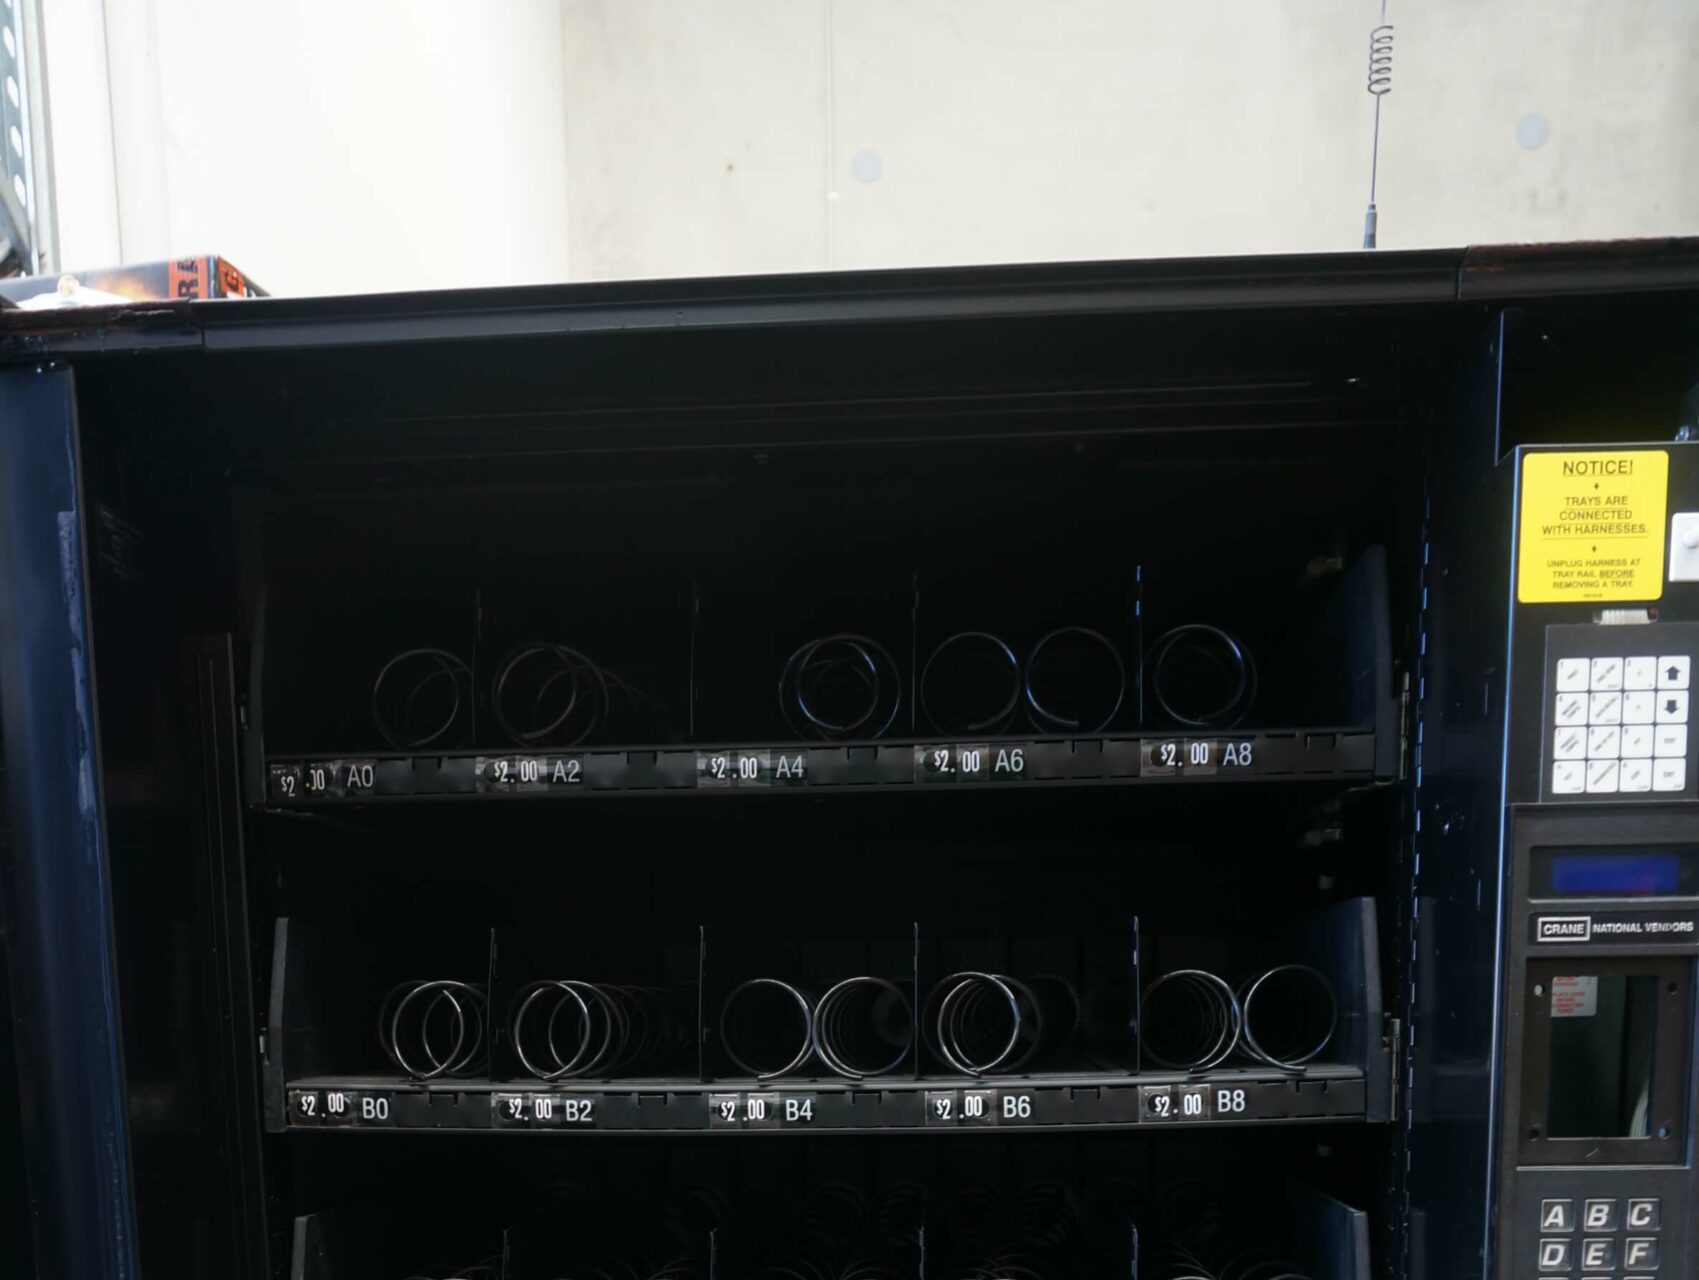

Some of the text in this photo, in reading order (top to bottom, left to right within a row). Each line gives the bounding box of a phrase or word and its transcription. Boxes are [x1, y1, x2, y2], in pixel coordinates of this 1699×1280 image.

[1563, 460, 1633, 475] NOTICE!
[1565, 496, 1629, 506] TRAYS ARE
[1559, 510, 1633, 521] CONNECTED
[1542, 524, 1649, 535] WITH HARNESSES.
[1547, 560, 1583, 568] UNPLUG
[1630, 558, 1640, 566] AT
[1577, 570, 1596, 578] RAIL
[1600, 569, 1634, 577] BEFORE
[1552, 581, 1599, 589] REMOVING
[994, 749, 1024, 772] A6
[1222, 742, 1252, 766] A8
[347, 765, 374, 787] A0
[552, 760, 580, 783] A2
[776, 755, 804, 778] A4
[1543, 921, 1694, 935] CRANE NATIONAL VENDORS
[362, 1097, 389, 1119] B0
[565, 1099, 593, 1122] B2
[785, 1099, 813, 1121] B4
[1003, 1095, 1031, 1118] B6
[1217, 1089, 1245, 1112] B8
[1544, 1203, 1653, 1227] A B C
[1541, 1242, 1650, 1266] D E F
